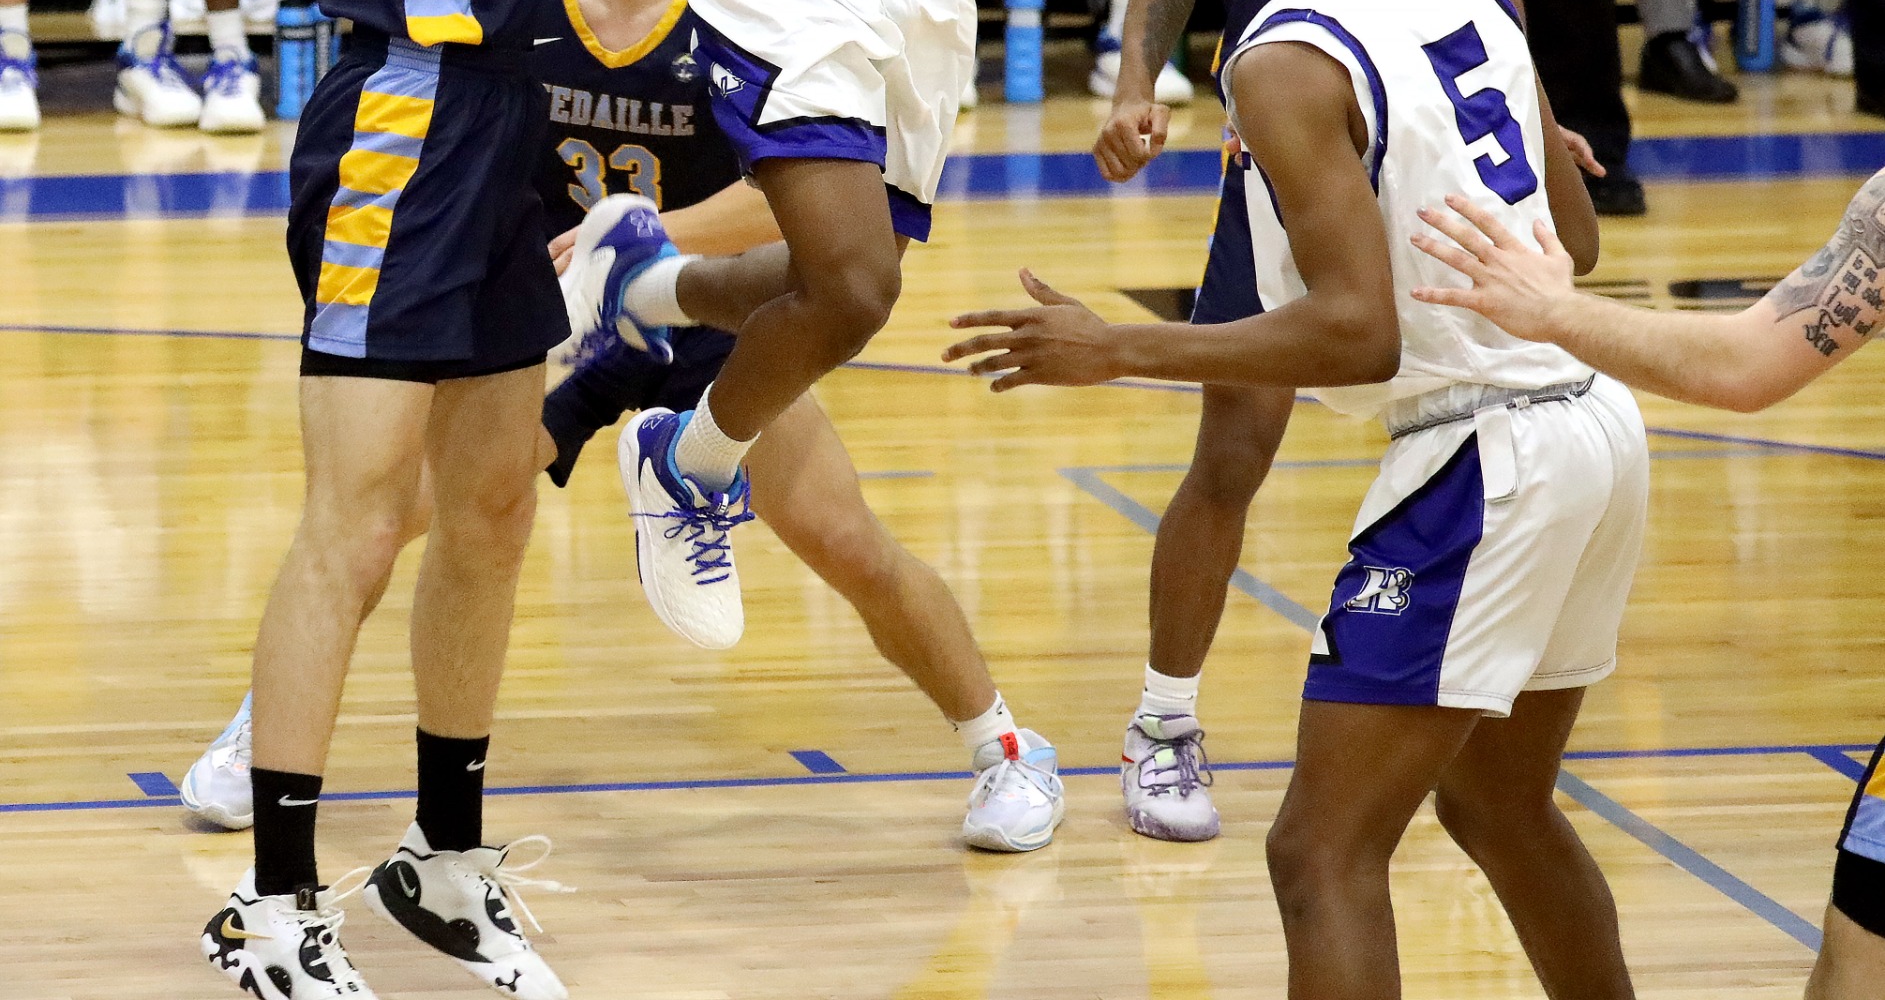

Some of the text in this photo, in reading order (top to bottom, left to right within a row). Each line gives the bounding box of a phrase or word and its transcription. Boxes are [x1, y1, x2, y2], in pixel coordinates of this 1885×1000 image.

[542, 83, 695, 137] EDAILLE
[1420, 19, 1538, 206] 5
[555, 136, 663, 214] 33
